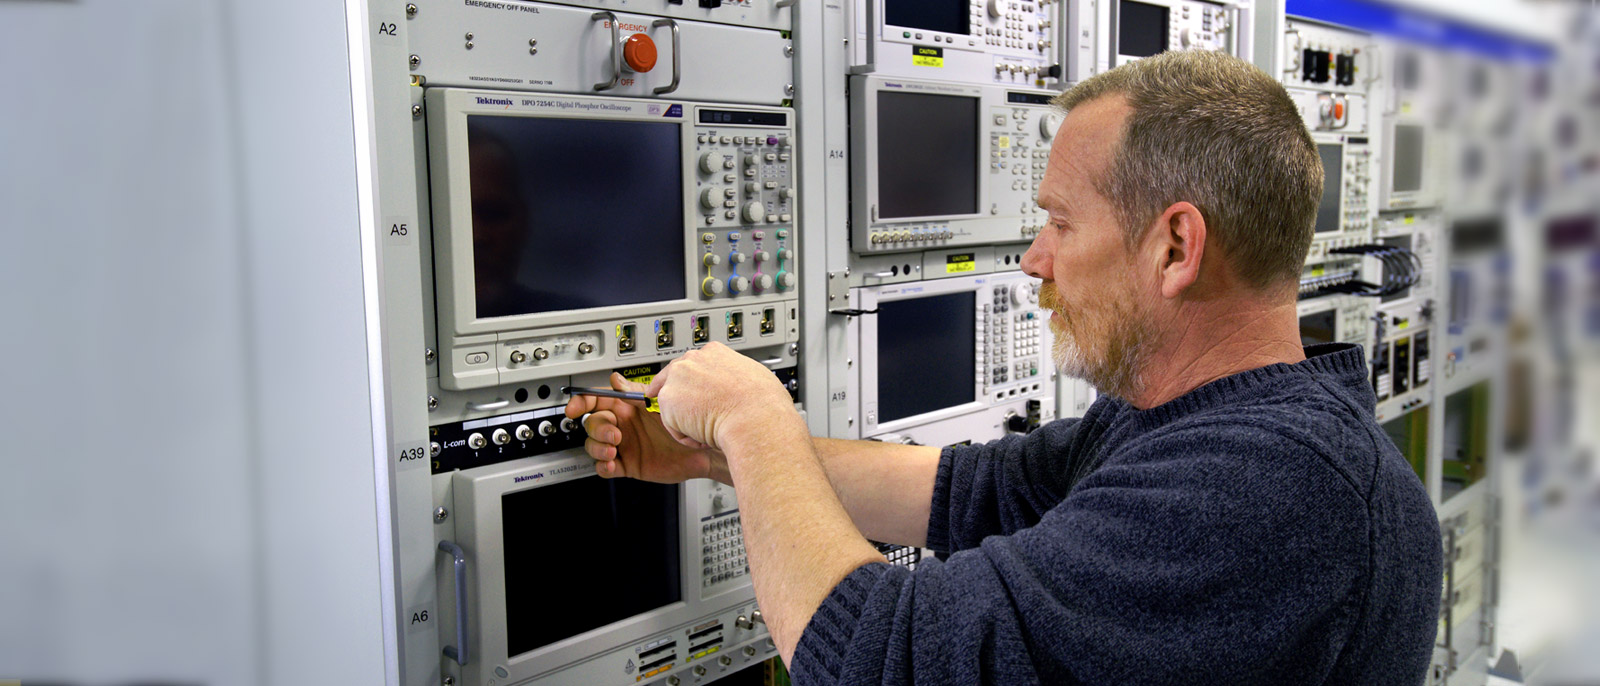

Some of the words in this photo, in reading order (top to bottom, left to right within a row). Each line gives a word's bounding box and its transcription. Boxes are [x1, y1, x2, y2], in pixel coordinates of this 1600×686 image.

[465, 0, 505, 10] EMERGENCY
[520, 6, 540, 14] PANEL
[378, 21, 397, 36] A2
[603, 21, 648, 32] ERGENCY
[620, 78, 635, 86] OFF
[475, 97, 513, 107] Tektronix
[521, 99, 536, 107] DPO
[556, 101, 574, 110] Digital
[574, 102, 599, 111] Phosphor
[600, 103, 632, 112] Oscilloscope
[829, 150, 844, 159] A14
[390, 223, 408, 236] A5
[623, 367, 651, 377] CAUTION
[832, 391, 846, 402] A19
[443, 438, 466, 449] L-com
[399, 446, 425, 463] A39
[513, 472, 544, 483] Tektronix
[411, 610, 429, 625] A6
